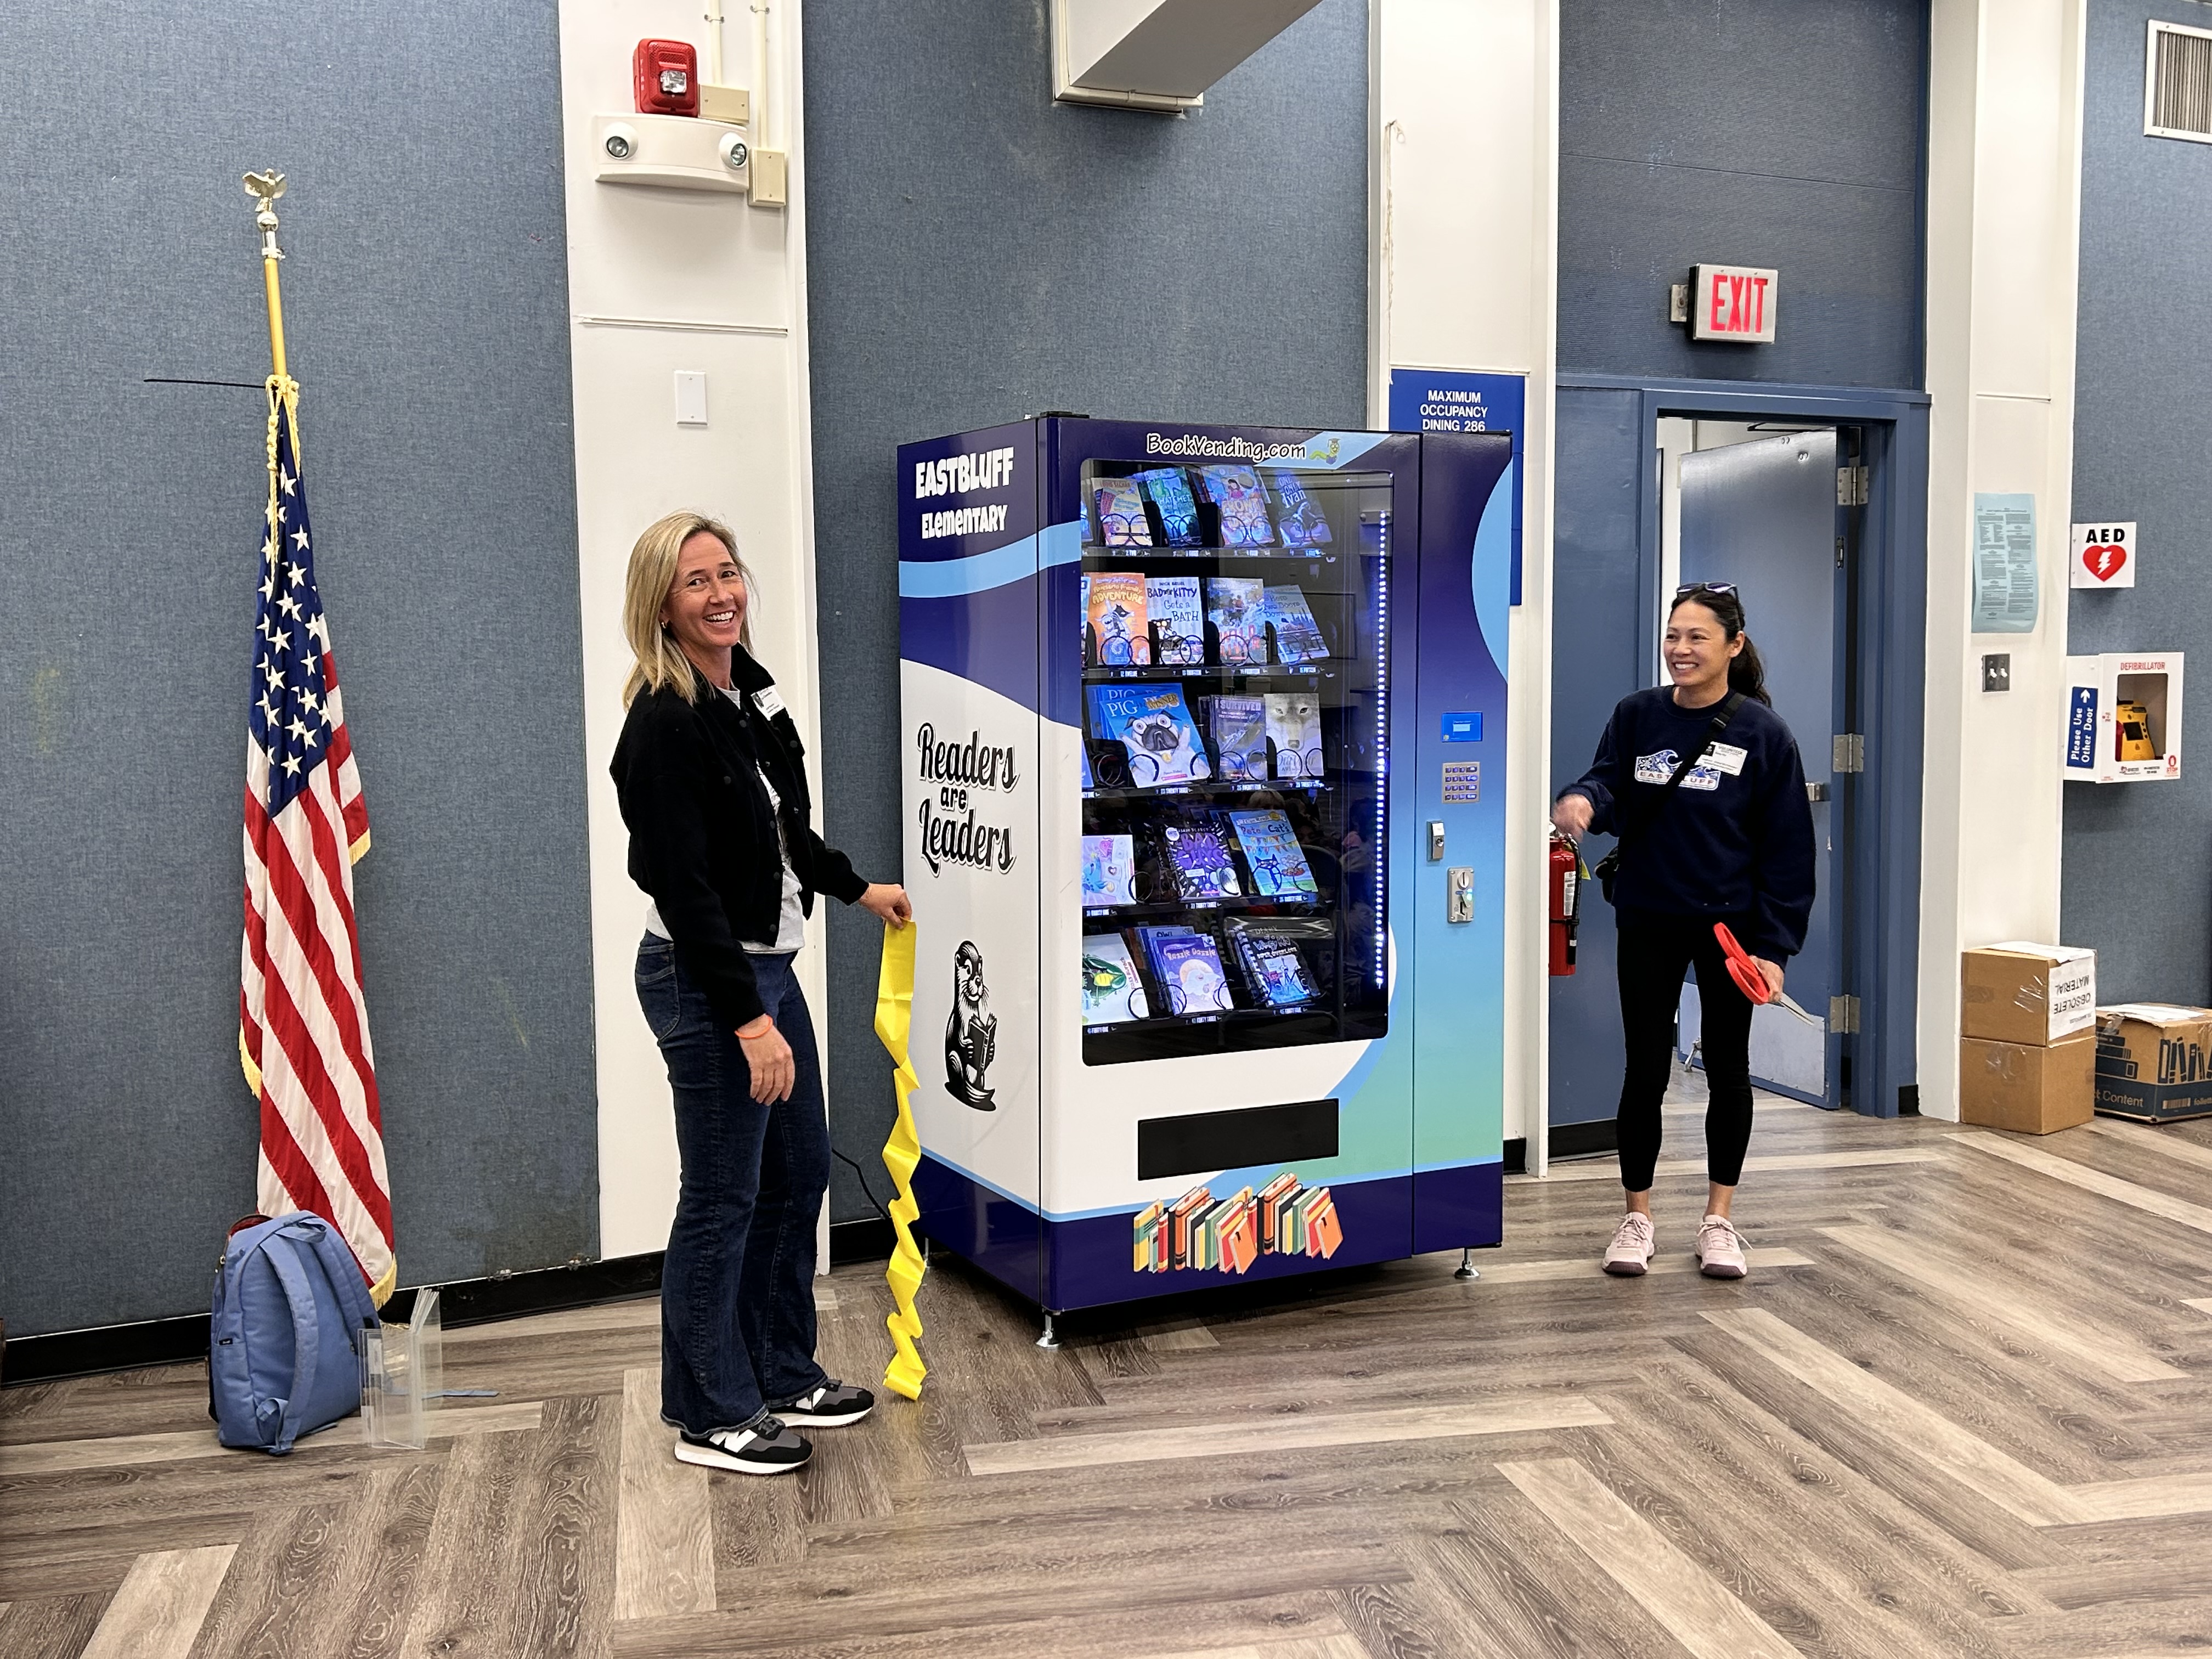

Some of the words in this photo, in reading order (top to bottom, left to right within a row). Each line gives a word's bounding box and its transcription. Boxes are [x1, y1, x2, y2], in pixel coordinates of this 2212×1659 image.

[1711, 274, 1768, 334] EXIT
[1427, 390, 1481, 403] MAXIMUM
[1420, 404, 1488, 419] OCCUPANCY
[1422, 419, 1460, 431] DINING
[1464, 420, 1485, 432] 286
[1147, 433, 1306, 462] BookVending.com
[915, 447, 1014, 499] EASTBLUFF
[1158, 494, 1190, 504] HATCHET
[1281, 490, 1306, 508] Ivan
[2086, 528, 2125, 543] AED
[1092, 591, 1144, 605] ADVENTURE
[1147, 588, 1163, 599] BAD
[1173, 587, 1197, 598] KITTY
[1164, 599, 1183, 610] Gets
[1171, 611, 1199, 622] BATH
[2120, 662, 2165, 670] DEFIBRILLATOR
[1107, 700, 1138, 717] PIG
[1147, 694, 1178, 709] WINNER
[1220, 699, 1261, 712] SURVIVED
[2073, 708, 2083, 725] Use
[2084, 707, 2094, 731] Door
[2071, 730, 2081, 761] Please
[2081, 735, 2091, 763] Other
[917, 721, 1019, 791] Readers
[940, 786, 968, 810] are
[919, 798, 1014, 874] Leaders
[1240, 826, 1261, 834] Pete
[1268, 823, 1290, 832] Cat's
[1181, 832, 1218, 851] BAD
[1176, 849, 1226, 870] GUYS
[1192, 947, 1216, 958] Dazzle
[2055, 975, 2090, 996] MATERIAL
[2053, 992, 2091, 1014] OBSOLETE
[2103, 1090, 2143, 1108] Content
